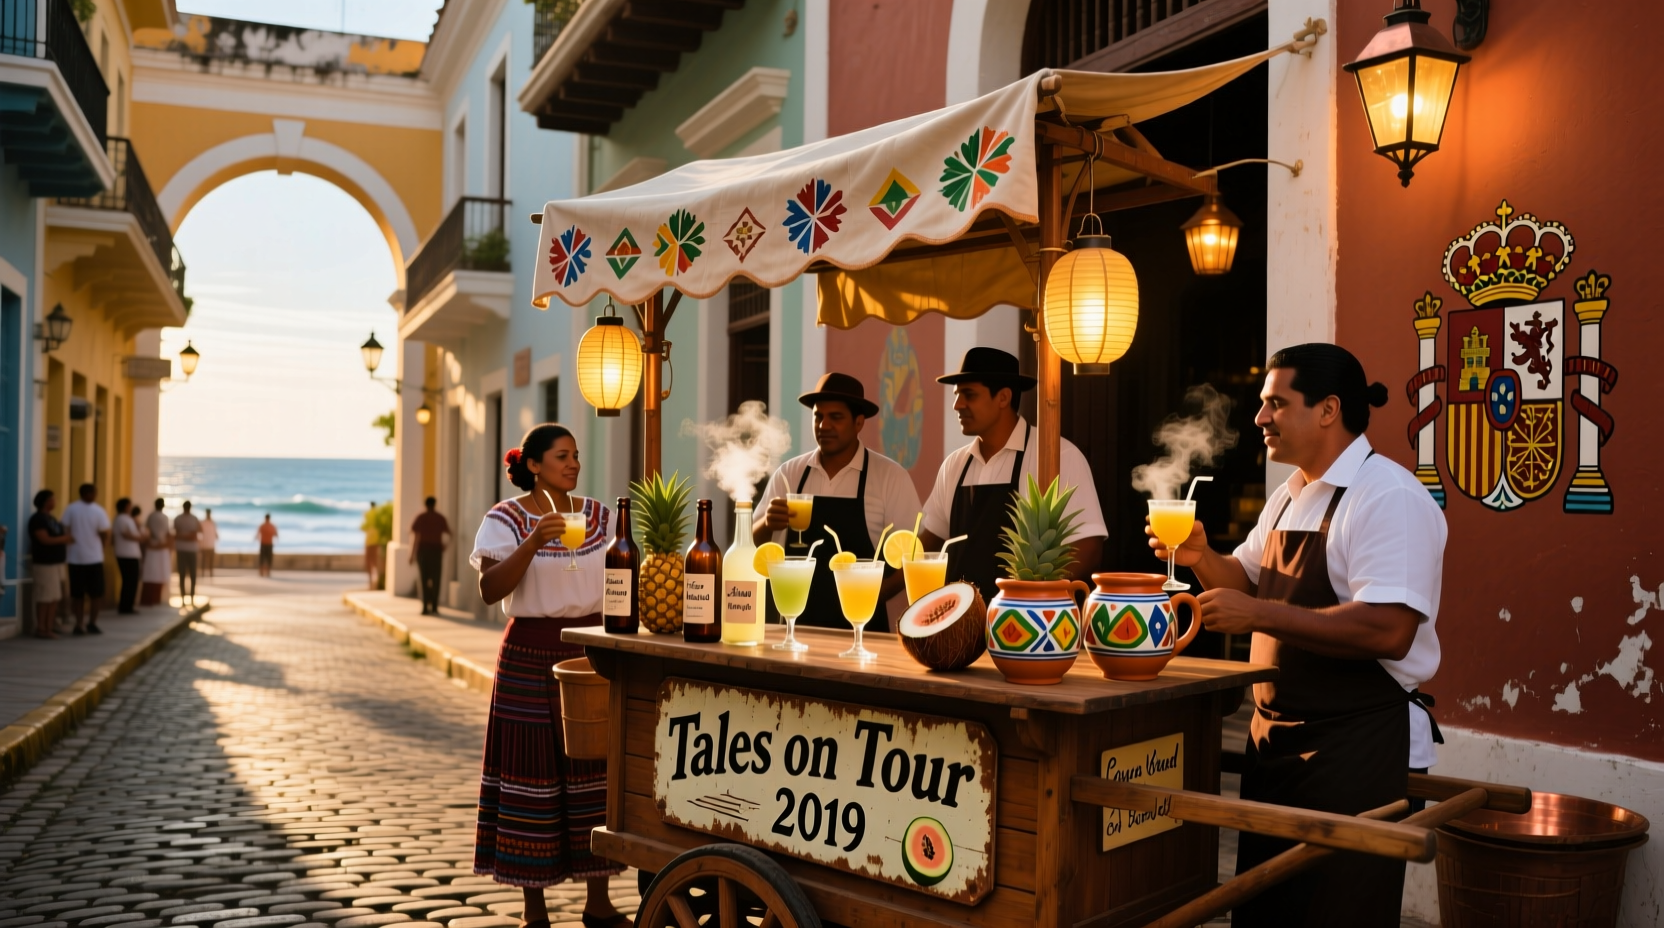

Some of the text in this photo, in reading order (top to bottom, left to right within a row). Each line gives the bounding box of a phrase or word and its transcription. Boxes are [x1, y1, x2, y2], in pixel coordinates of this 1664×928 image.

[668, 710, 976, 808] Tales on Tour
[771, 787, 866, 852] 2019
